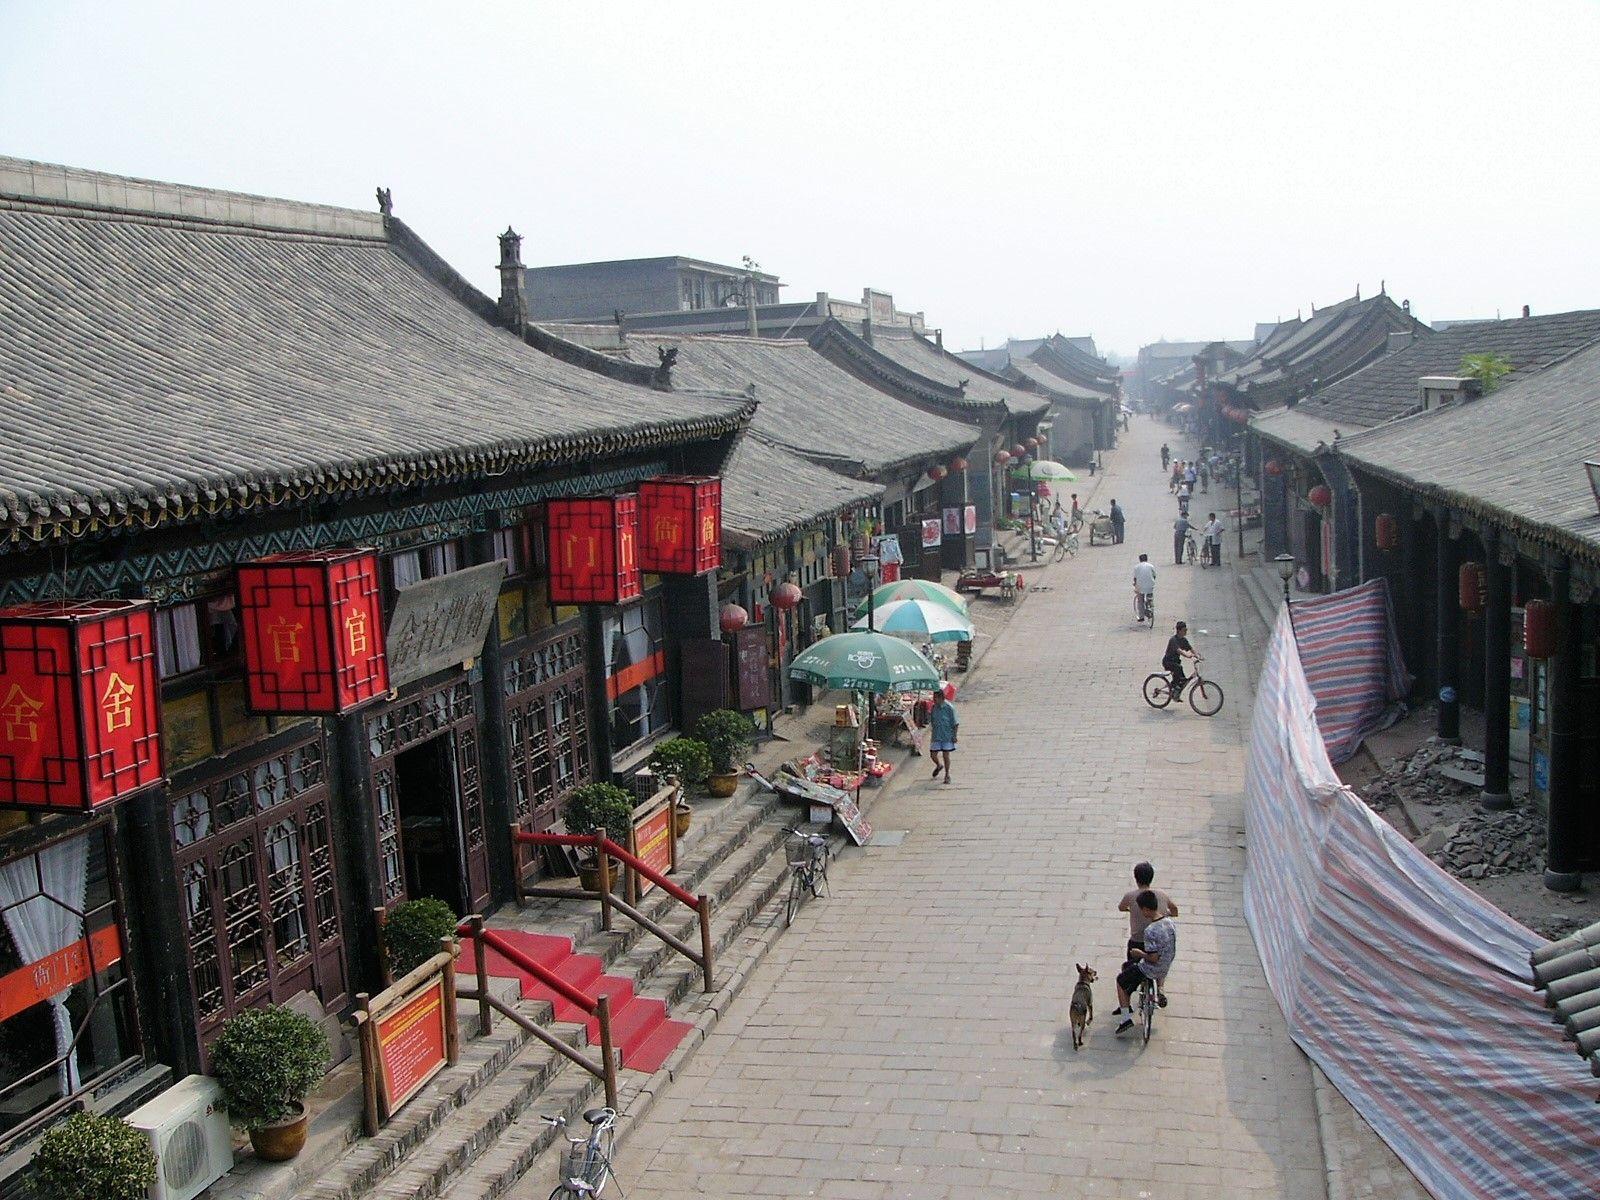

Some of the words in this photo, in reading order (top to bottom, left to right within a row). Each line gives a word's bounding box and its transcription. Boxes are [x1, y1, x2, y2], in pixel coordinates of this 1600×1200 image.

[566, 534, 595, 568] 门
[621, 532, 634, 567] 门
[267, 616, 303, 664] 官
[344, 608, 367, 657] 官
[1, 683, 44, 742] 舍
[101, 672, 135, 733] 舍
